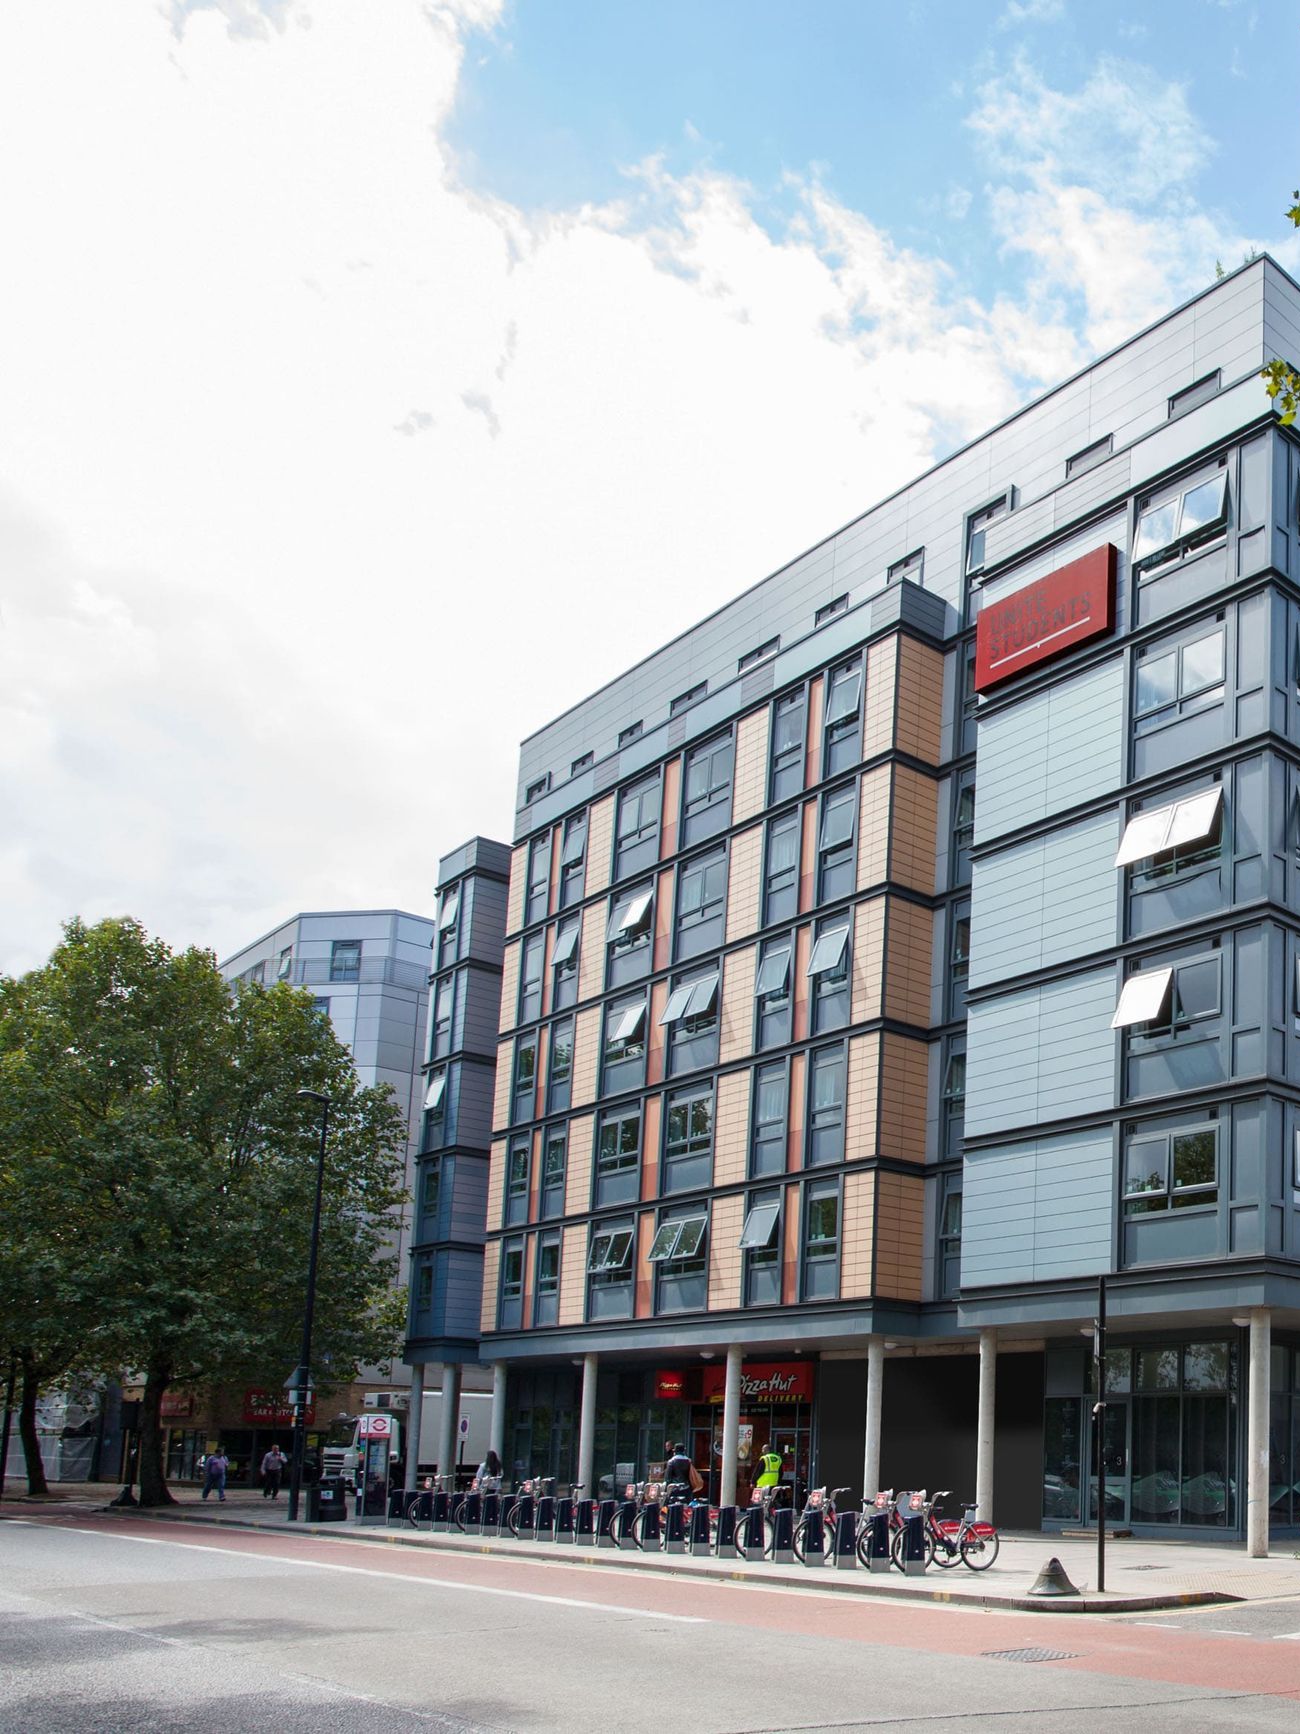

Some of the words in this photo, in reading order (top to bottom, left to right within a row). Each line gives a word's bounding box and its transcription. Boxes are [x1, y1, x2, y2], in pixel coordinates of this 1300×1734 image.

[990, 588, 1048, 635] UNITE
[990, 591, 1092, 660] STUDENTS
[757, 1394, 803, 1402] DELIVERY
[769, 1372, 797, 1392] Hut
